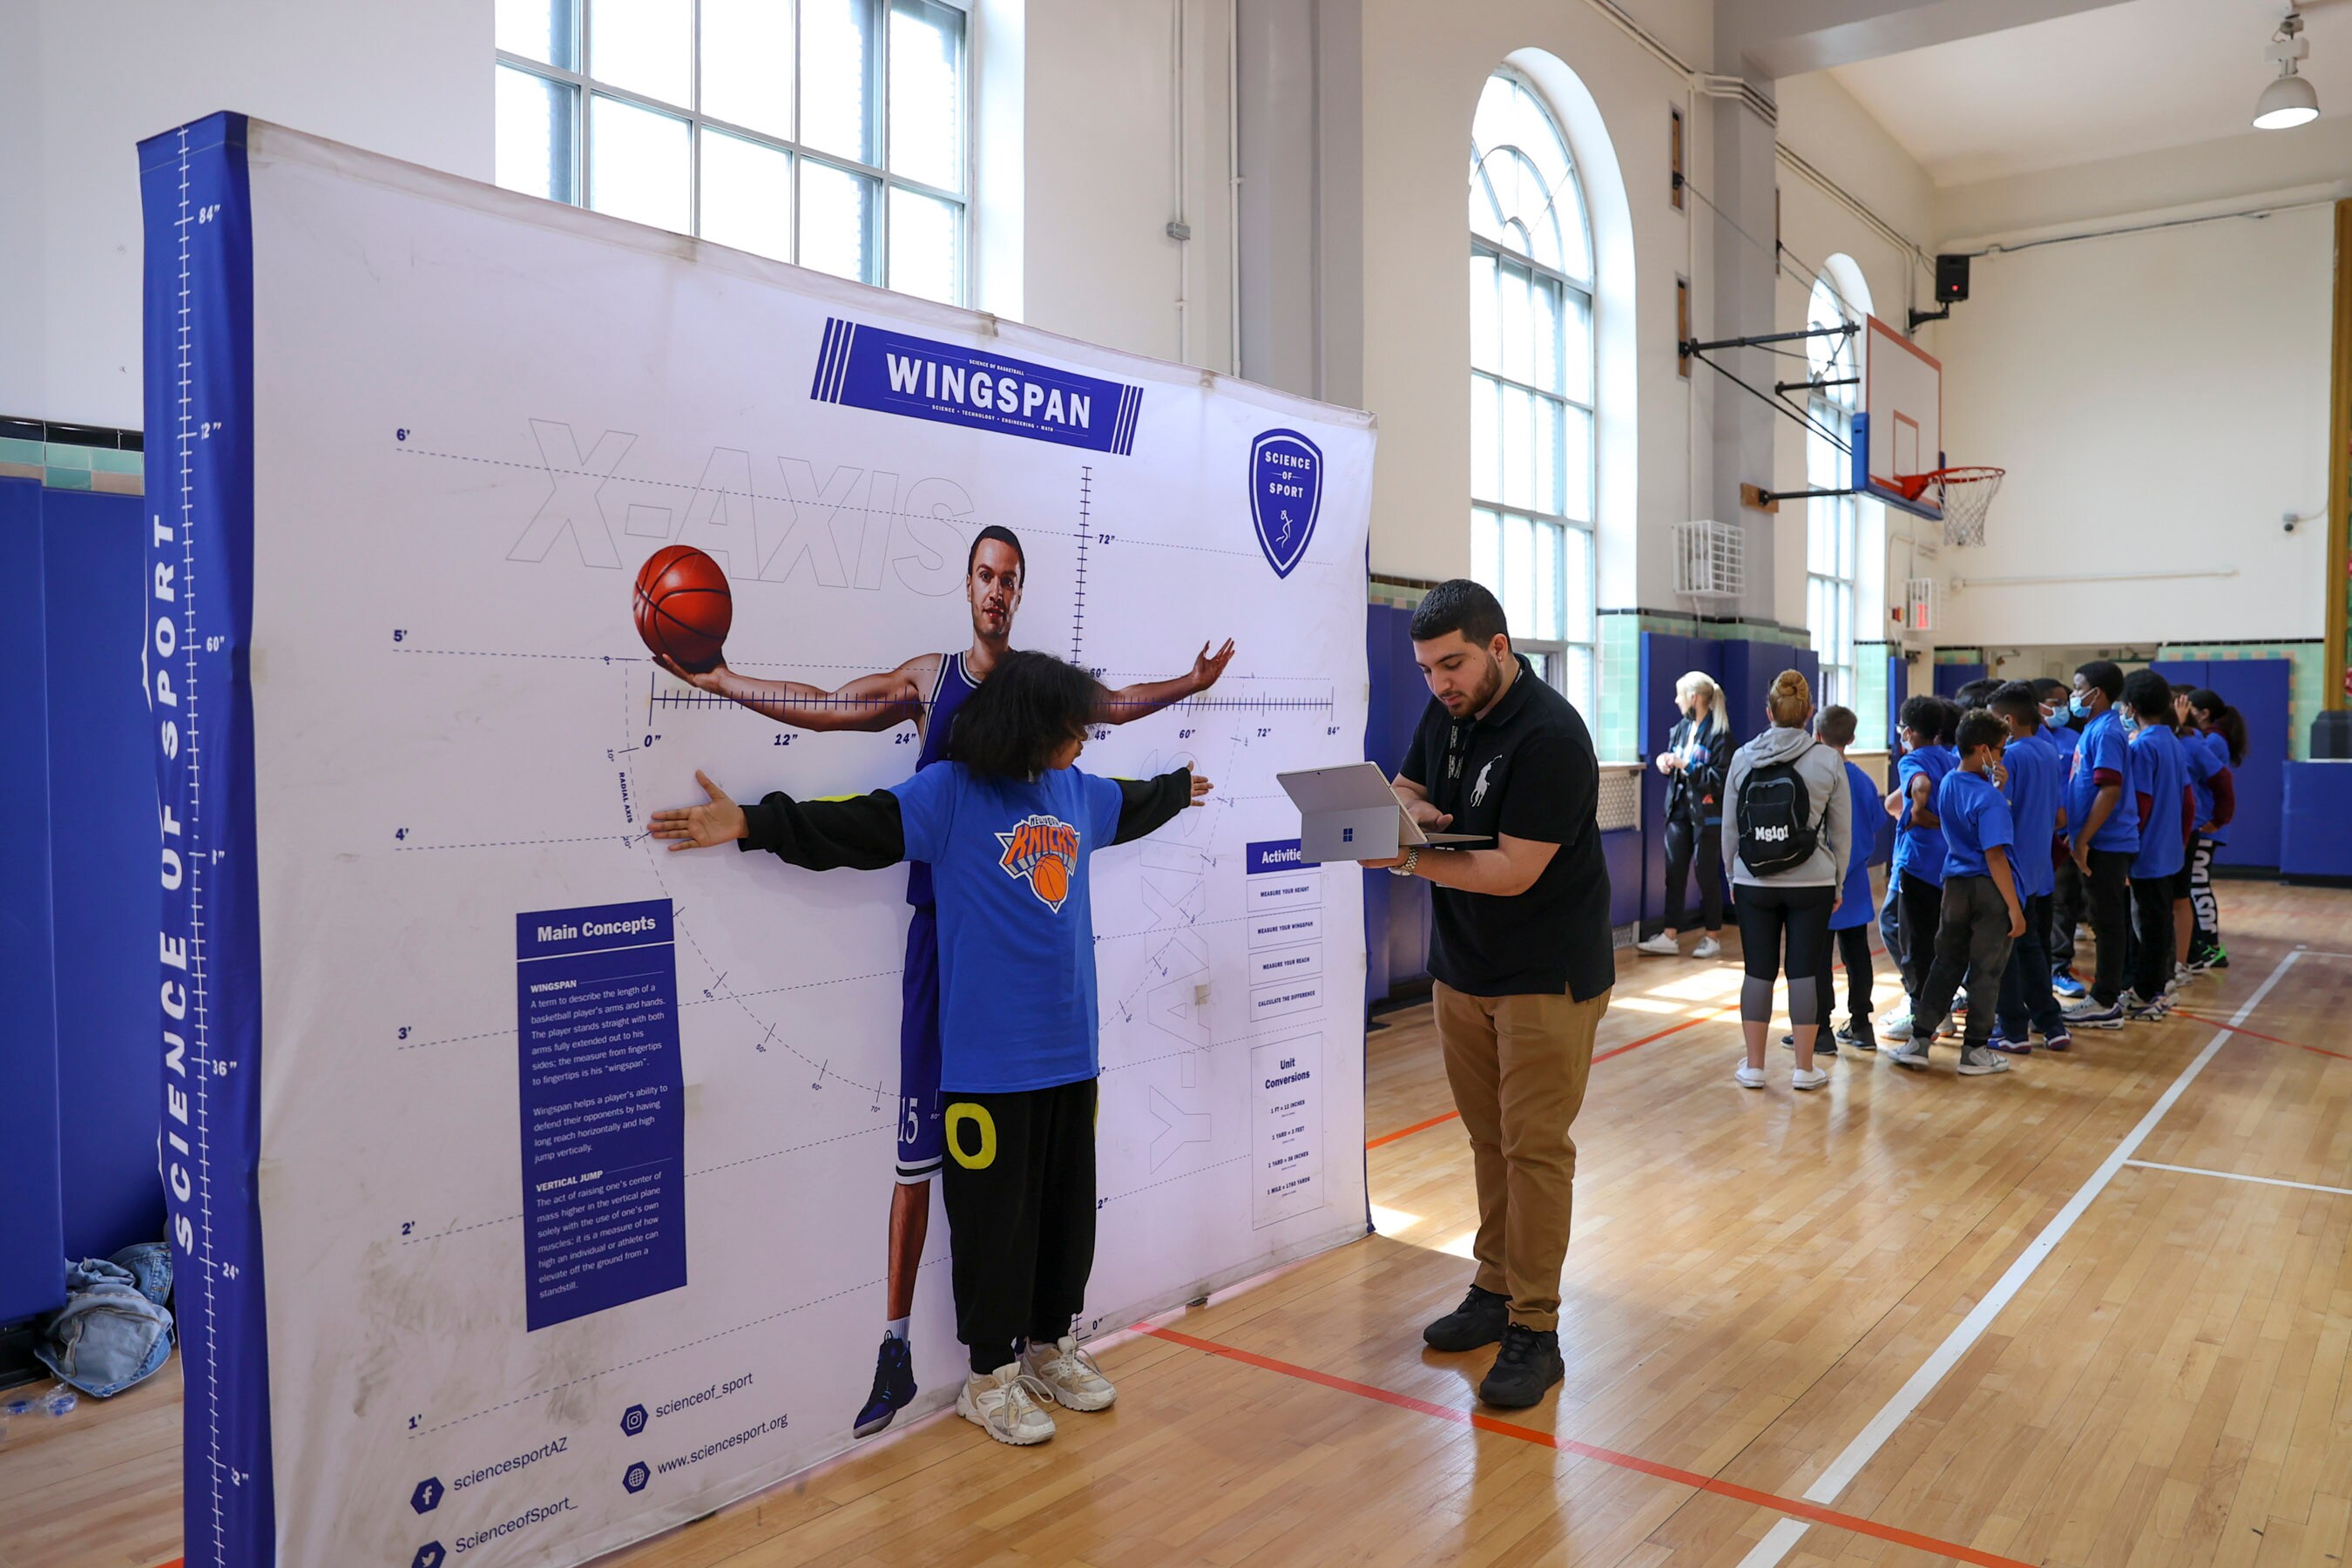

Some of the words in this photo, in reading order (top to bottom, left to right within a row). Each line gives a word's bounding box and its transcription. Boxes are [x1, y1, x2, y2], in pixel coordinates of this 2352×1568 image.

[199, 205, 221, 224] 84"
[969, 359, 989, 368] SCIENCE
[997, 365, 1024, 375] BASKETBALL
[886, 352, 1091, 429] WINGSPAN
[962, 410, 995, 420] TECHNOLOGY
[1002, 418, 1035, 428] ENGINEERING
[396, 429, 411, 441] 6'
[1265, 450, 1311, 470] SCIENCE
[1281, 470, 1293, 481] OF
[1269, 482, 1304, 498] SPORT
[1098, 533, 1115, 545] 72"
[155, 515, 178, 760] SPORT
[206, 637, 226, 652] 60"
[394, 629, 408, 642] 5'
[644, 734, 662, 747] 0"
[774, 733, 799, 747] 12"
[895, 733, 916, 745] 24"
[1094, 730, 1112, 740] 48"
[1179, 729, 1196, 740] 60"
[1257, 728, 1271, 738] 72"
[1328, 727, 1341, 736] 84"
[618, 772, 628, 802] RADIAL
[625, 805, 633, 823] AXIS
[395, 828, 409, 841] 4'
[1003, 824, 1078, 865] KNICKS
[1261, 848, 1301, 864] Activitie
[537, 924, 578, 943] Main
[582, 916, 657, 937] Concepts
[530, 980, 578, 992] WINGSPAN
[569, 992, 601, 1003] describe
[617, 986, 639, 997] length
[1258, 997, 1281, 1007] CALCULATE
[1291, 990, 1315, 1000] DIFFERENCE
[531, 1011, 571, 1024] basketball
[573, 1007, 603, 1019] player's
[605, 1004, 624, 1013] arms
[625, 1001, 639, 1010] and
[398, 1026, 412, 1040] 3'
[548, 1028, 571, 1038] player
[573, 1023, 599, 1032] stands
[601, 1017, 630, 1028] straight
[648, 1012, 665, 1021] both
[531, 1046, 552, 1055] arms
[554, 1042, 571, 1051] fully
[571, 1036, 607, 1048] extended
[573, 1052, 607, 1063] measure
[628, 1043, 662, 1054] fingertips
[1280, 1058, 1295, 1070] Unit
[543, 1071, 579, 1084] fingertips
[1265, 1071, 1310, 1089] Conversions
[160, 930, 193, 1256] SCIENCE
[533, 1104, 572, 1116] Wingspan
[574, 1099, 596, 1108] helps
[605, 1091, 634, 1104] player's
[636, 1087, 659, 1097] ability
[533, 1119, 562, 1132] defend
[564, 1116, 581, 1125] their
[583, 1108, 625, 1122] opponents
[625, 1105, 634, 1114] by
[636, 1101, 661, 1111] having
[898, 1096, 918, 1144] 15
[534, 1138, 552, 1146] long
[553, 1132, 576, 1142] reach
[578, 1123, 621, 1137] horizontally
[623, 1119, 638, 1128] and
[639, 1116, 655, 1125] high
[534, 1152, 555, 1164] jump
[557, 1144, 592, 1157] vertically.
[536, 1177, 578, 1192] VERTICAL
[579, 1171, 603, 1182] JUMP
[553, 1194, 566, 1203] act
[568, 1191, 577, 1200] of
[578, 1186, 605, 1197] raising
[605, 1180, 627, 1191] one's
[629, 1175, 652, 1186] center
[654, 1171, 662, 1179] of
[537, 1212, 559, 1222] mass
[561, 1206, 585, 1217] higher
[611, 1192, 639, 1204] vertical
[640, 1187, 661, 1199] plane
[402, 1220, 416, 1235] 2'
[538, 1258, 556, 1268] high
[570, 1244, 606, 1260] individual
[617, 1235, 644, 1247] athlete
[645, 1231, 659, 1240] can
[539, 1281, 578, 1298] standstill.
[1092, 1319, 1103, 1330] 0"
[655, 1372, 754, 1418] scienceof_sport
[408, 1414, 423, 1430] 1'
[657, 1413, 789, 1475] www.sciencesport.org
[453, 1436, 569, 1491] sciencesportAZ
[455, 1496, 579, 1554] ScienceofSport_
